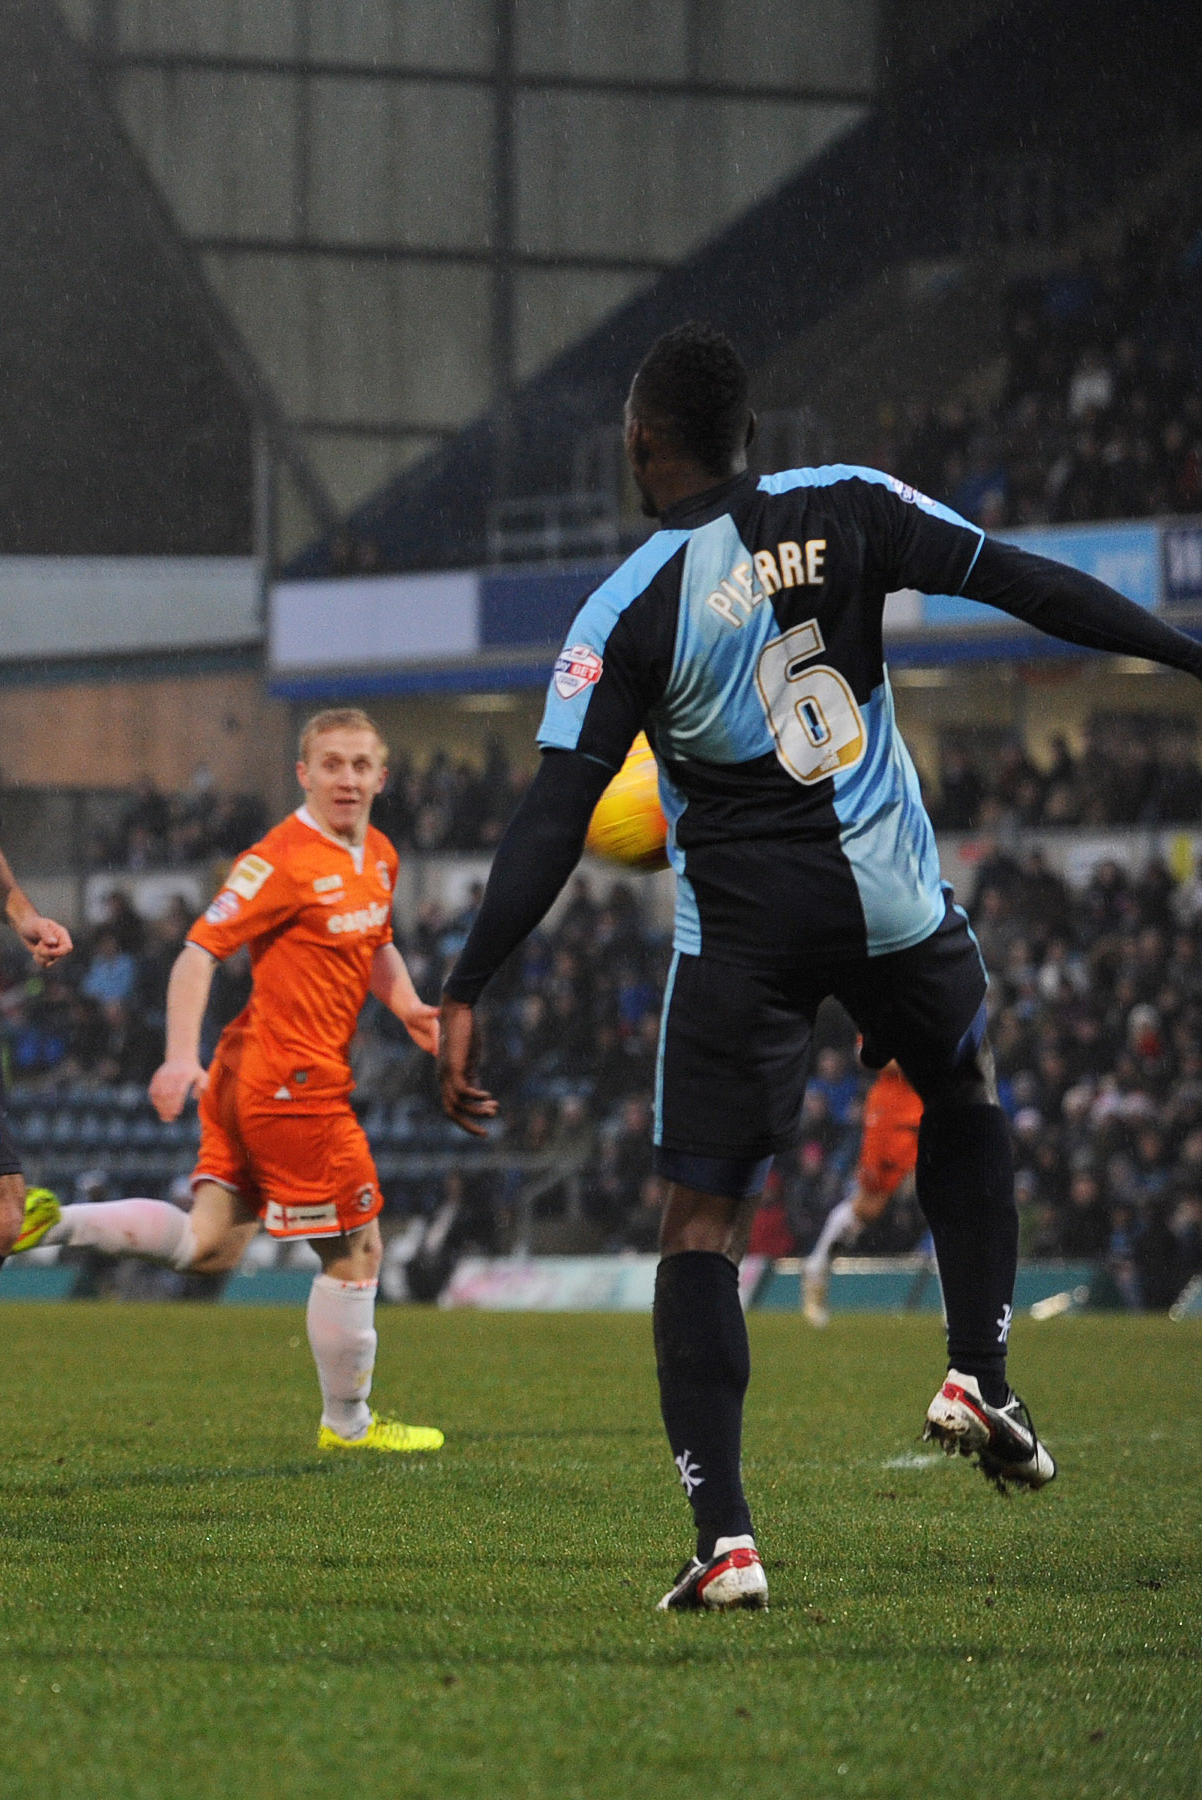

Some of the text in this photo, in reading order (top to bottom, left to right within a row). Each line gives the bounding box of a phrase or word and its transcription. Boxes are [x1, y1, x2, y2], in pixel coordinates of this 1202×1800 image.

[707, 538, 827, 630] PIERRE
[571, 662, 599, 679] BET
[753, 617, 867, 786] 6
